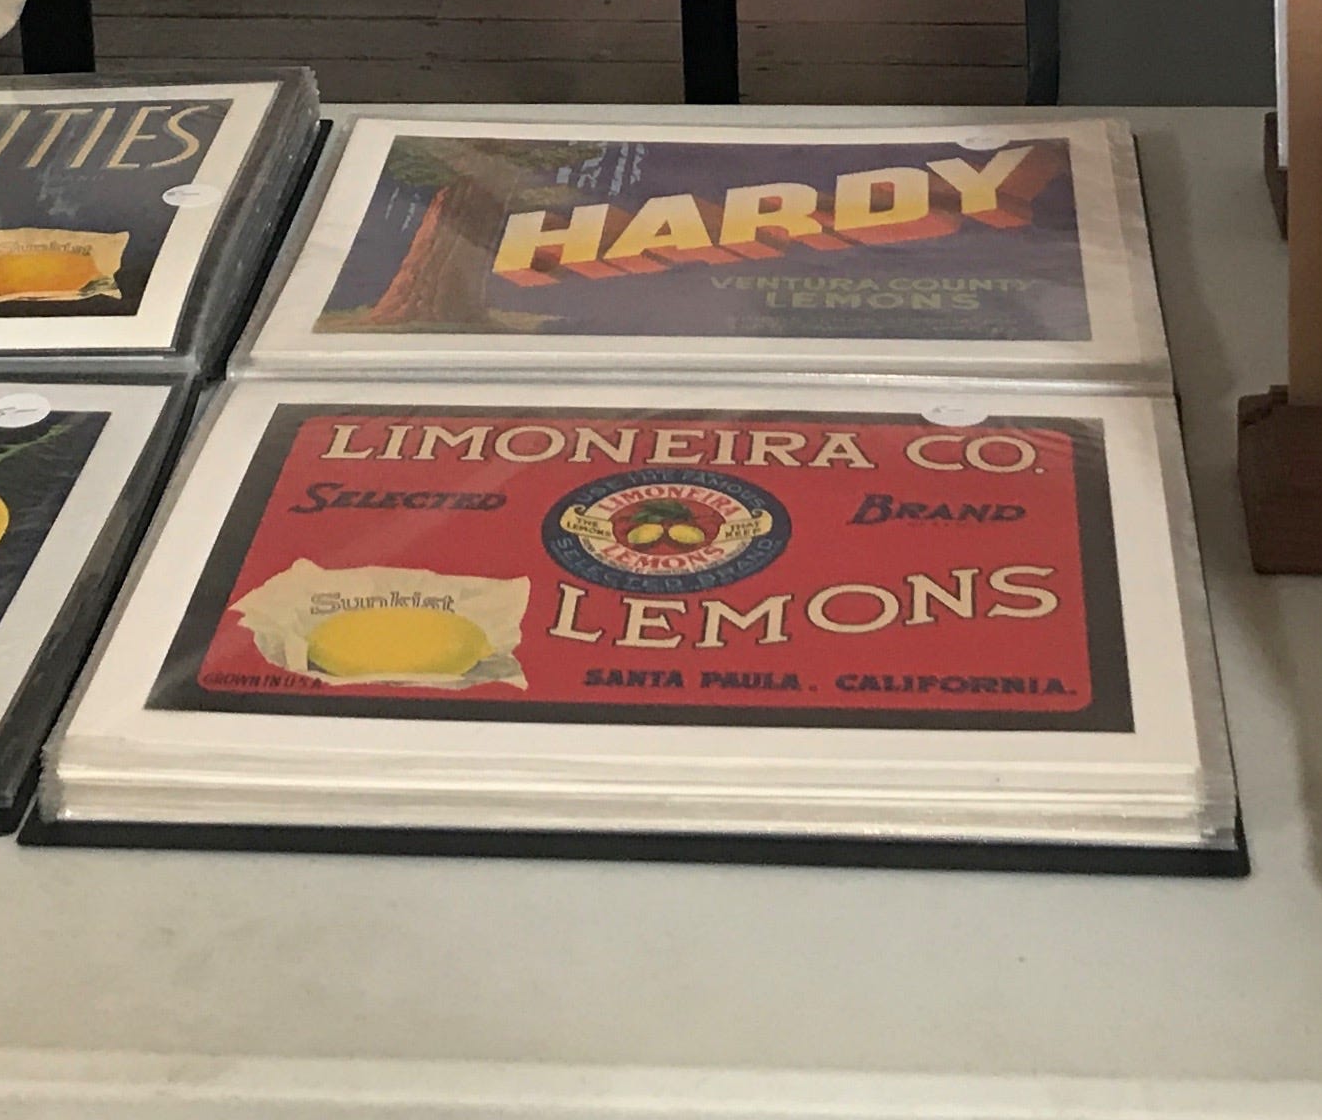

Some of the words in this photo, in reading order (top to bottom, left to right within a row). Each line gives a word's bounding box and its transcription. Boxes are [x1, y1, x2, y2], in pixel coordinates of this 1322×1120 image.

[494, 147, 1041, 280] HARDY
[711, 277, 875, 290] VENTURA
[889, 277, 1035, 291] COUNTY
[766, 292, 979, 309] LEMONS
[322, 423, 880, 469] LIMONEIRA
[902, 433, 1044, 474] CO.
[289, 483, 508, 513] SELECTED
[848, 493, 1027, 528] BRAND
[310, 591, 454, 615] Sunkist
[549, 567, 1060, 649] LEMONS
[584, 669, 687, 690] SANTA
[836, 674, 1078, 697] CALIFORNIA.
